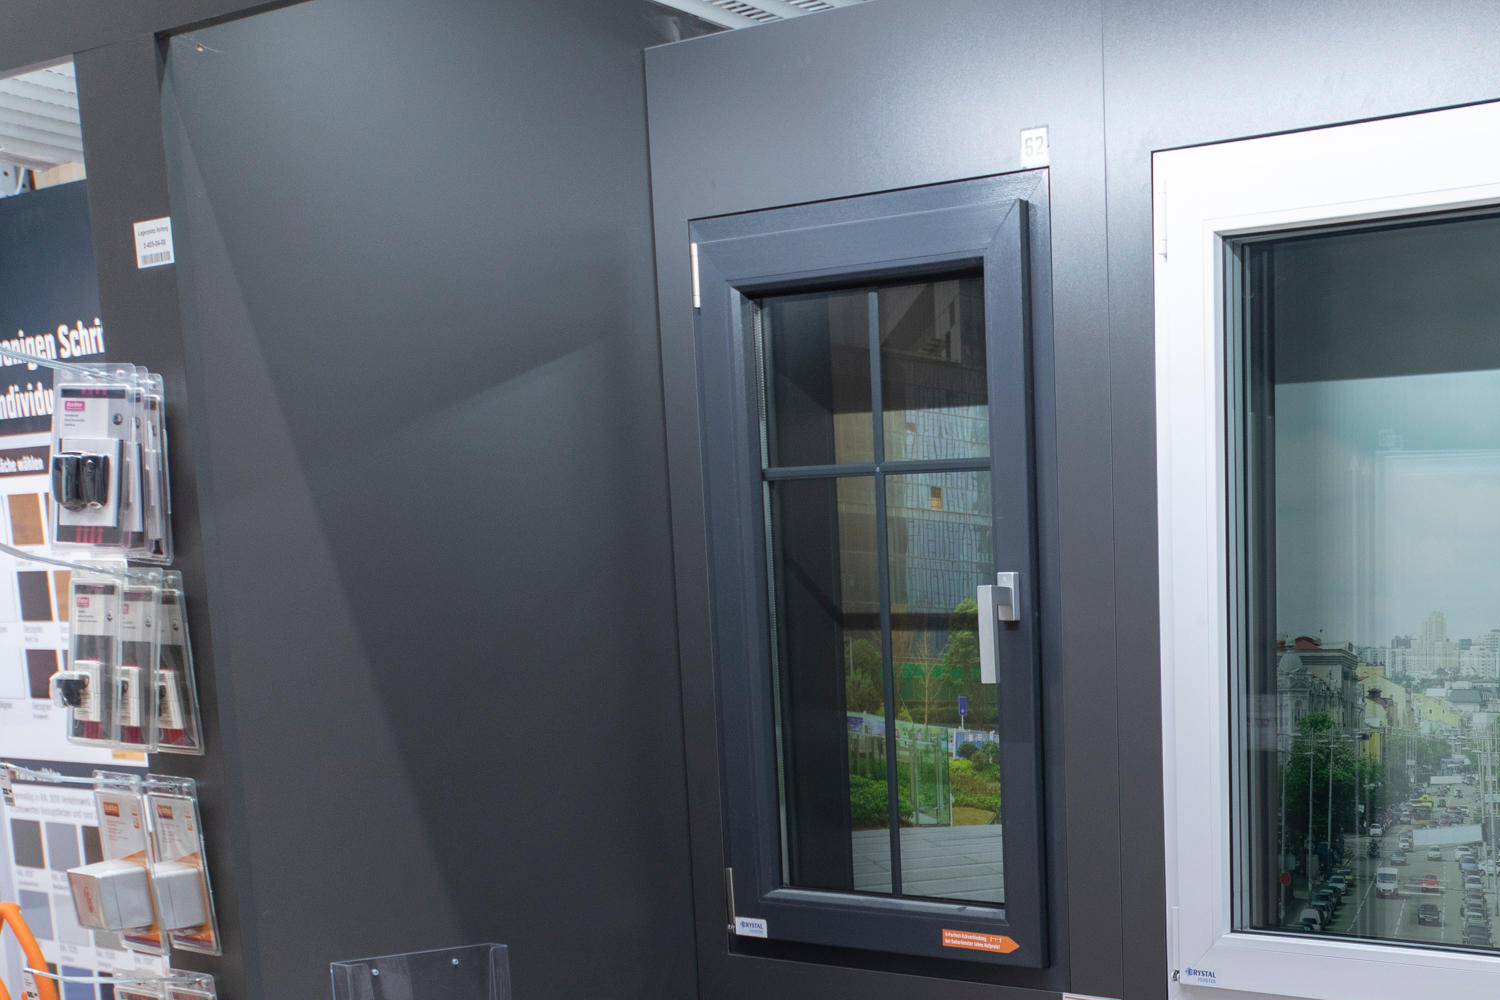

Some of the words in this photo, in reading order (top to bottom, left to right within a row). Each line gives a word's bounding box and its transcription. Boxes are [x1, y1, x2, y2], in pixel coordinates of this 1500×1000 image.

[1025, 135, 1045, 158] 62
[0, 328, 58, 371] enigen
[1187, 968, 1217, 979] CRYSTAL
